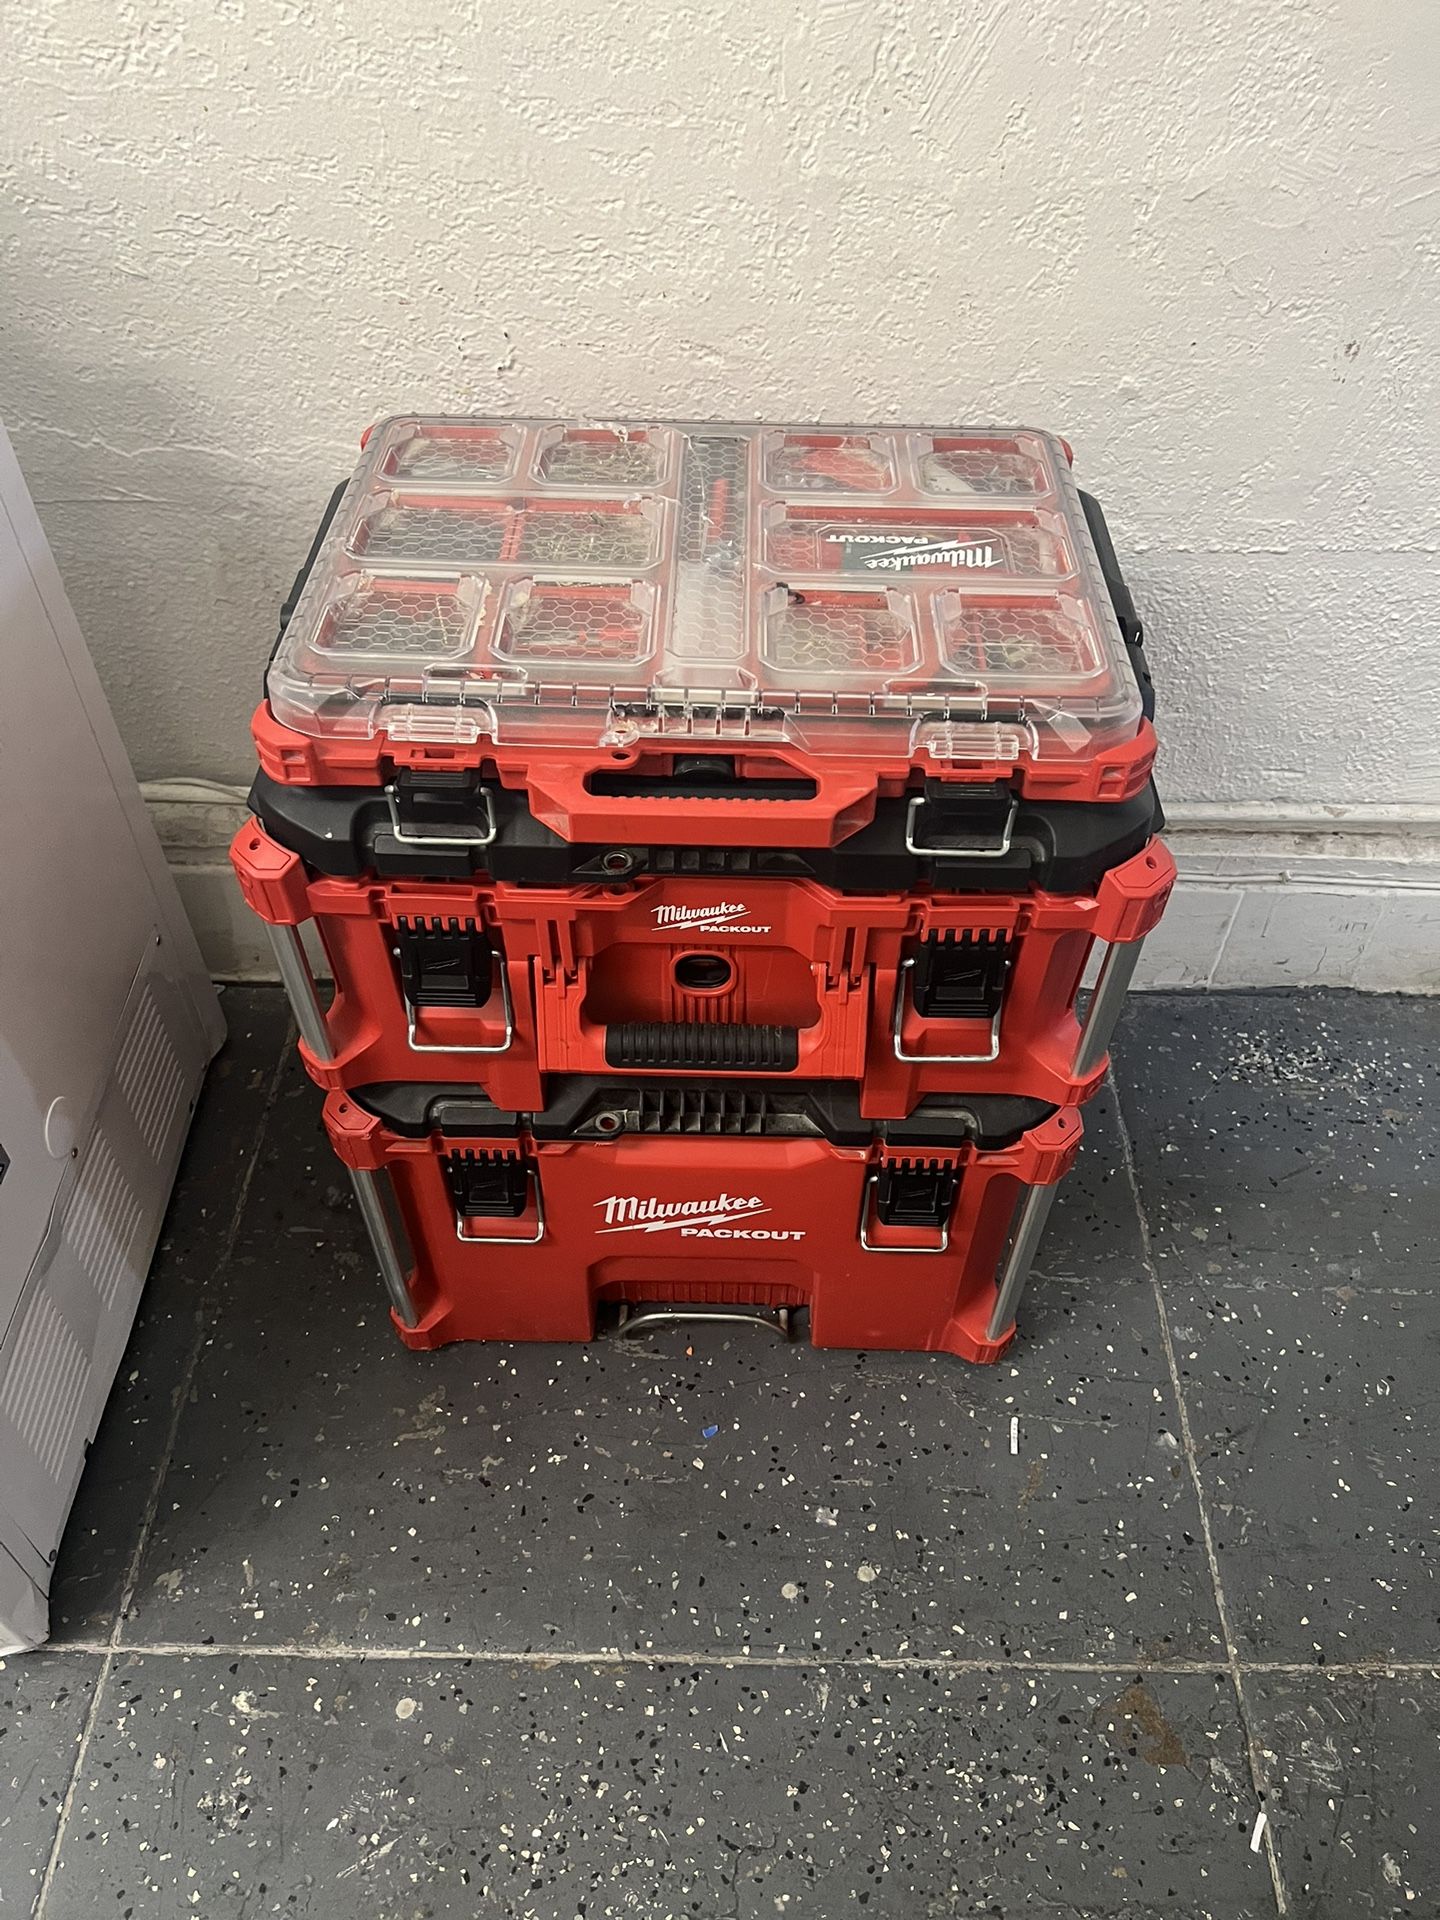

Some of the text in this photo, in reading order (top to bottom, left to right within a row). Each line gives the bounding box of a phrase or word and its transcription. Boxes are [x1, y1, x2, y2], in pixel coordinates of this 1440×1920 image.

[826, 534, 929, 544] PACKOUT
[864, 546, 1003, 571] Milwaukee
[651, 901, 747, 924] Milwaukee
[699, 925, 772, 933] PACKOUT
[593, 1193, 764, 1225] Milwaukee
[680, 1228, 806, 1241] PACKOUT
